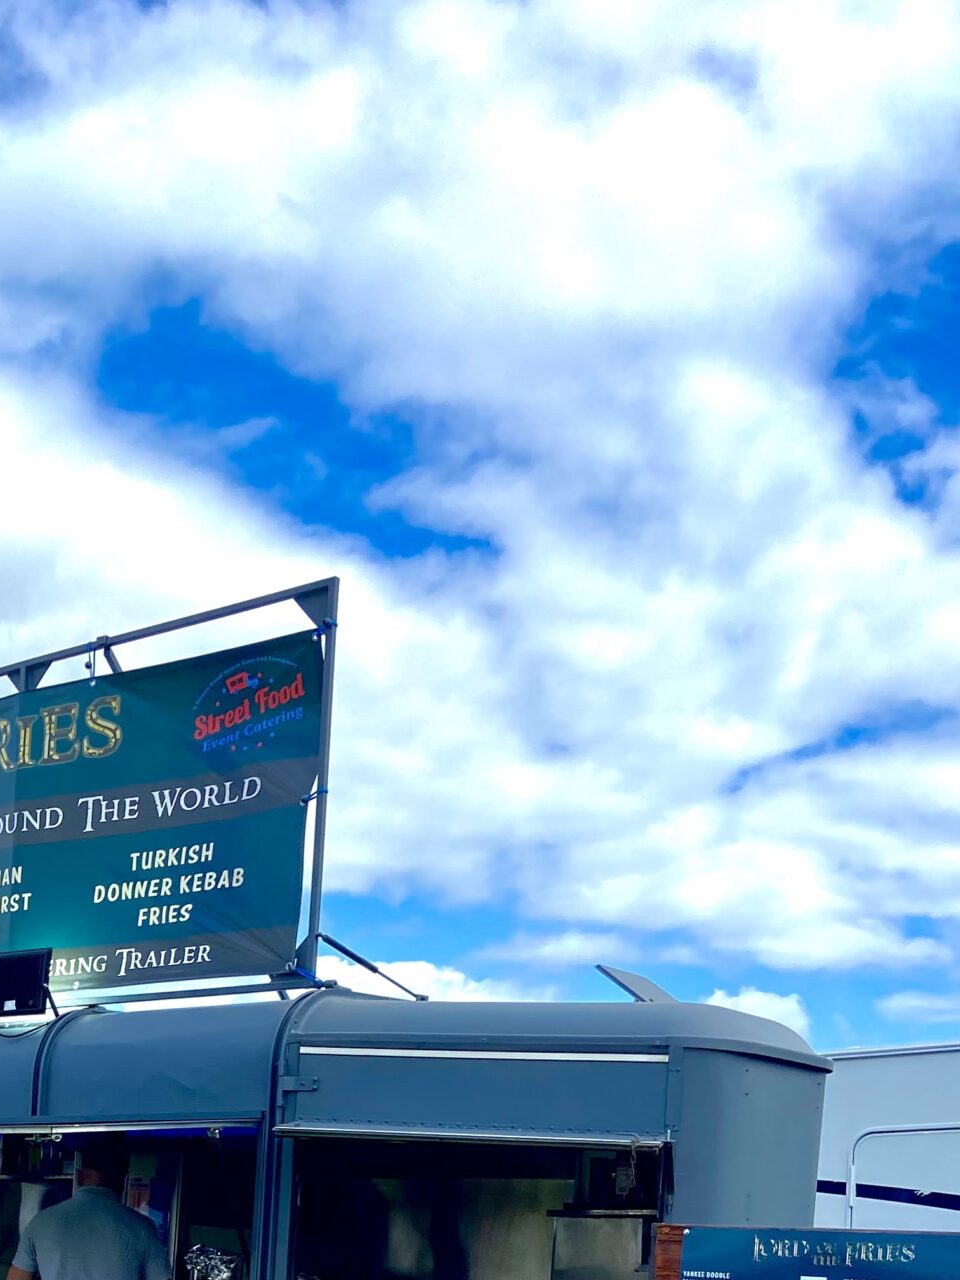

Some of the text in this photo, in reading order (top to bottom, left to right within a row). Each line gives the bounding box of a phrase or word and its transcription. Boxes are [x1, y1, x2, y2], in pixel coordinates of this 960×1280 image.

[194, 698, 251, 740] Street
[255, 672, 305, 714] Food
[202, 706, 304, 753] Event Catering
[77, 794, 140, 833] THE
[151, 776, 262, 819] WORLD
[130, 842, 215, 872] TURKISH
[93, 867, 245, 904] DONNER KEBAB
[137, 903, 194, 927] FRIES
[115, 944, 212, 977] TRAILER
[845, 1241, 915, 1267] FRIES
[706, 1271, 730, 1279] DOODLE
